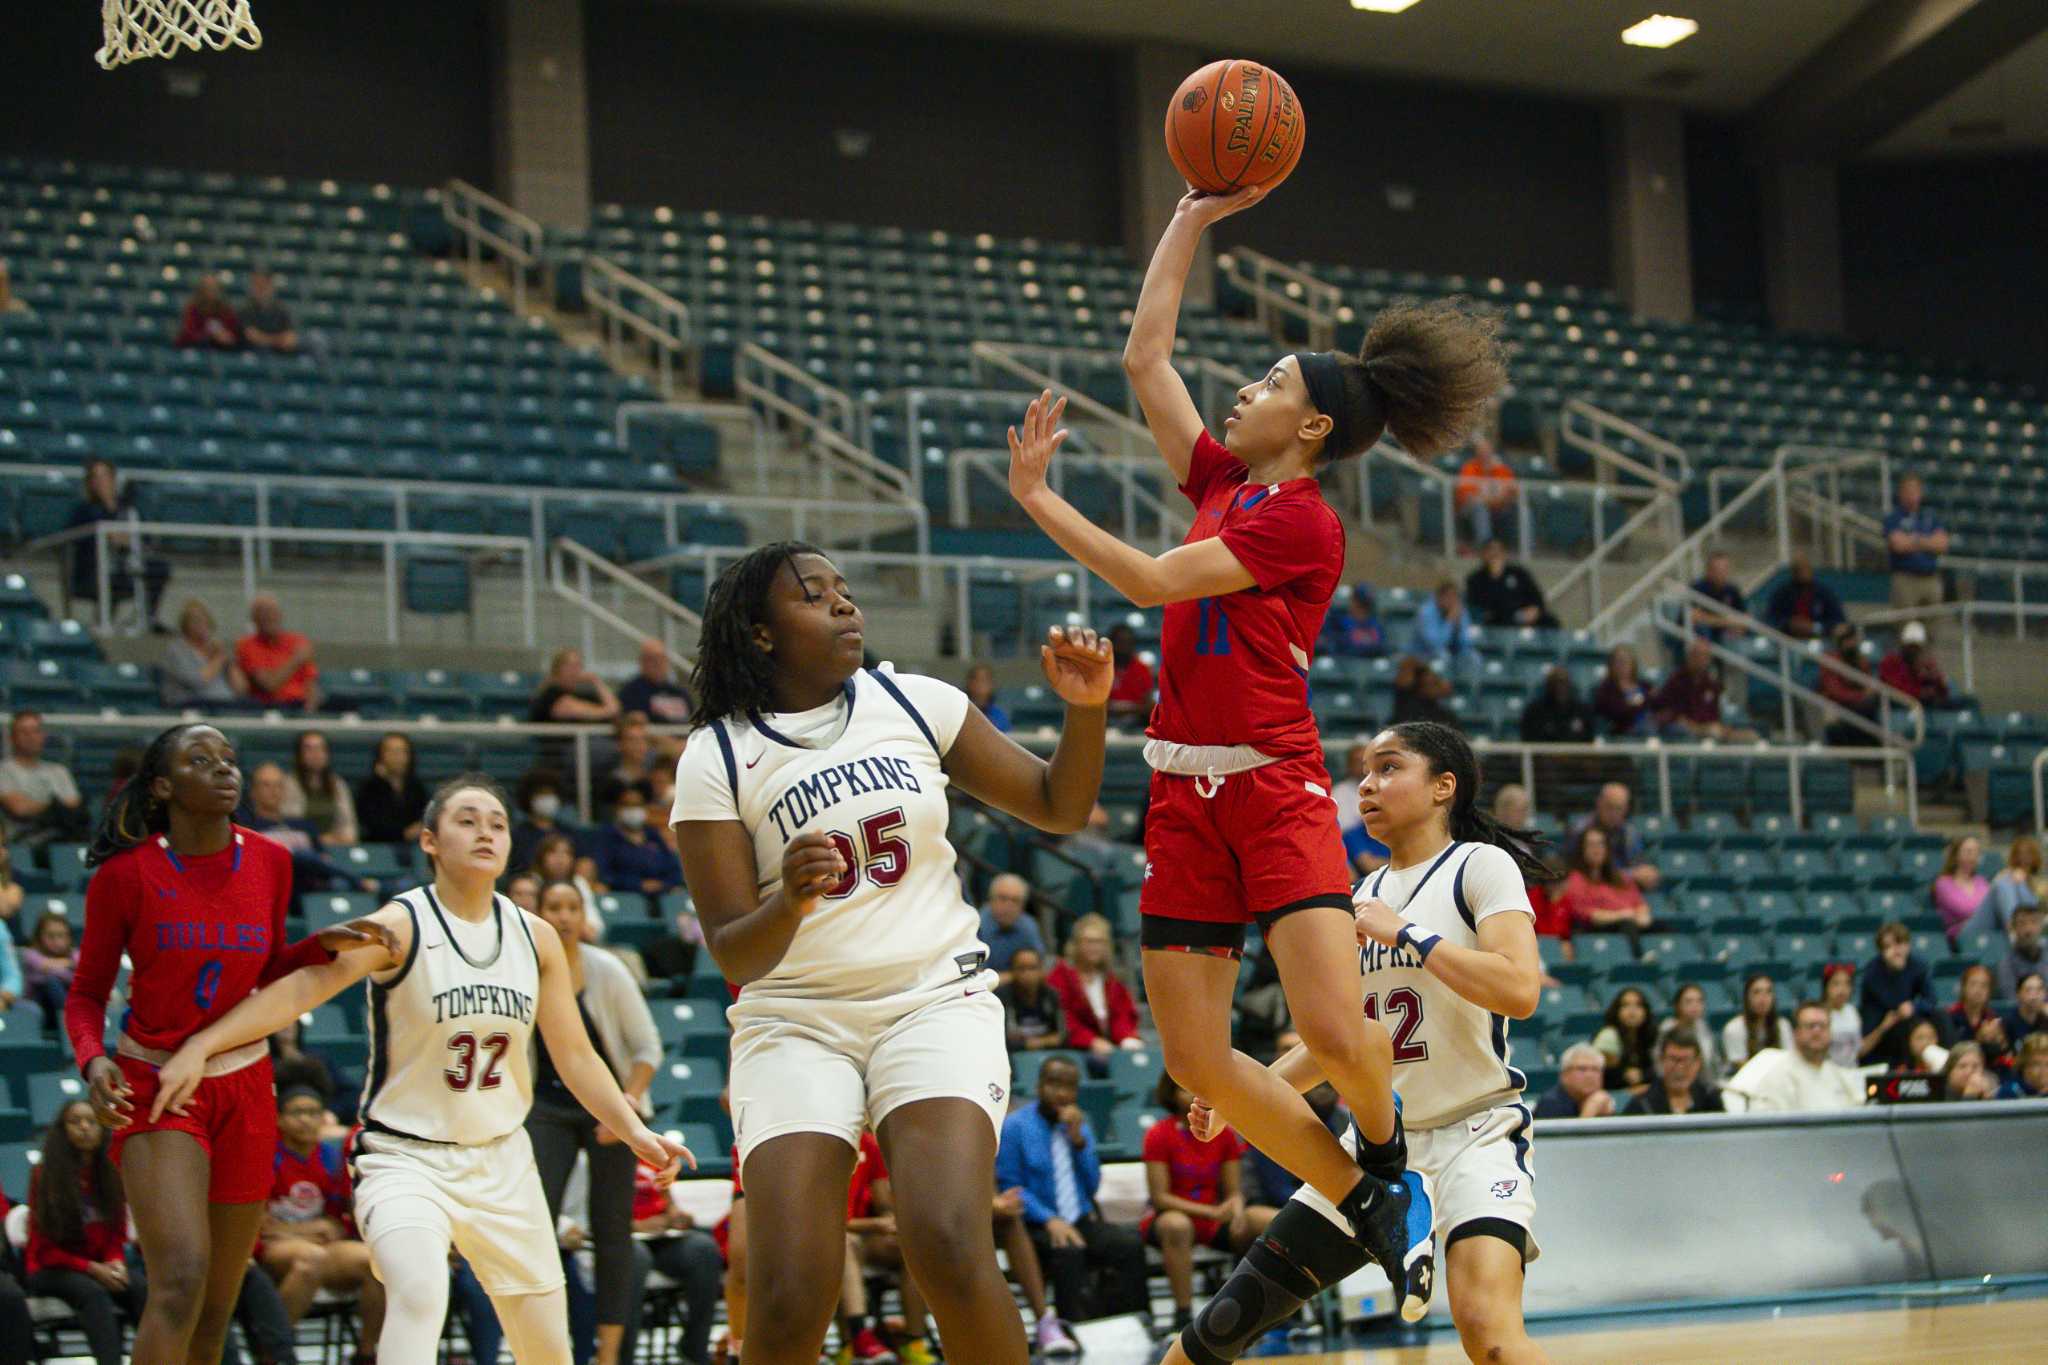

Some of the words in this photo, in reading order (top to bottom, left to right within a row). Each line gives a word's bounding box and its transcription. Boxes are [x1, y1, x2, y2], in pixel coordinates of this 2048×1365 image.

[1227, 66, 1263, 155] SPALDING
[1195, 597, 1232, 655] 11
[768, 756, 922, 845] TOMPKINS
[156, 921, 268, 953] DULLES
[193, 959, 224, 1009] 0
[432, 983, 533, 1025] TOMPKINS
[444, 1031, 512, 1092] 32
